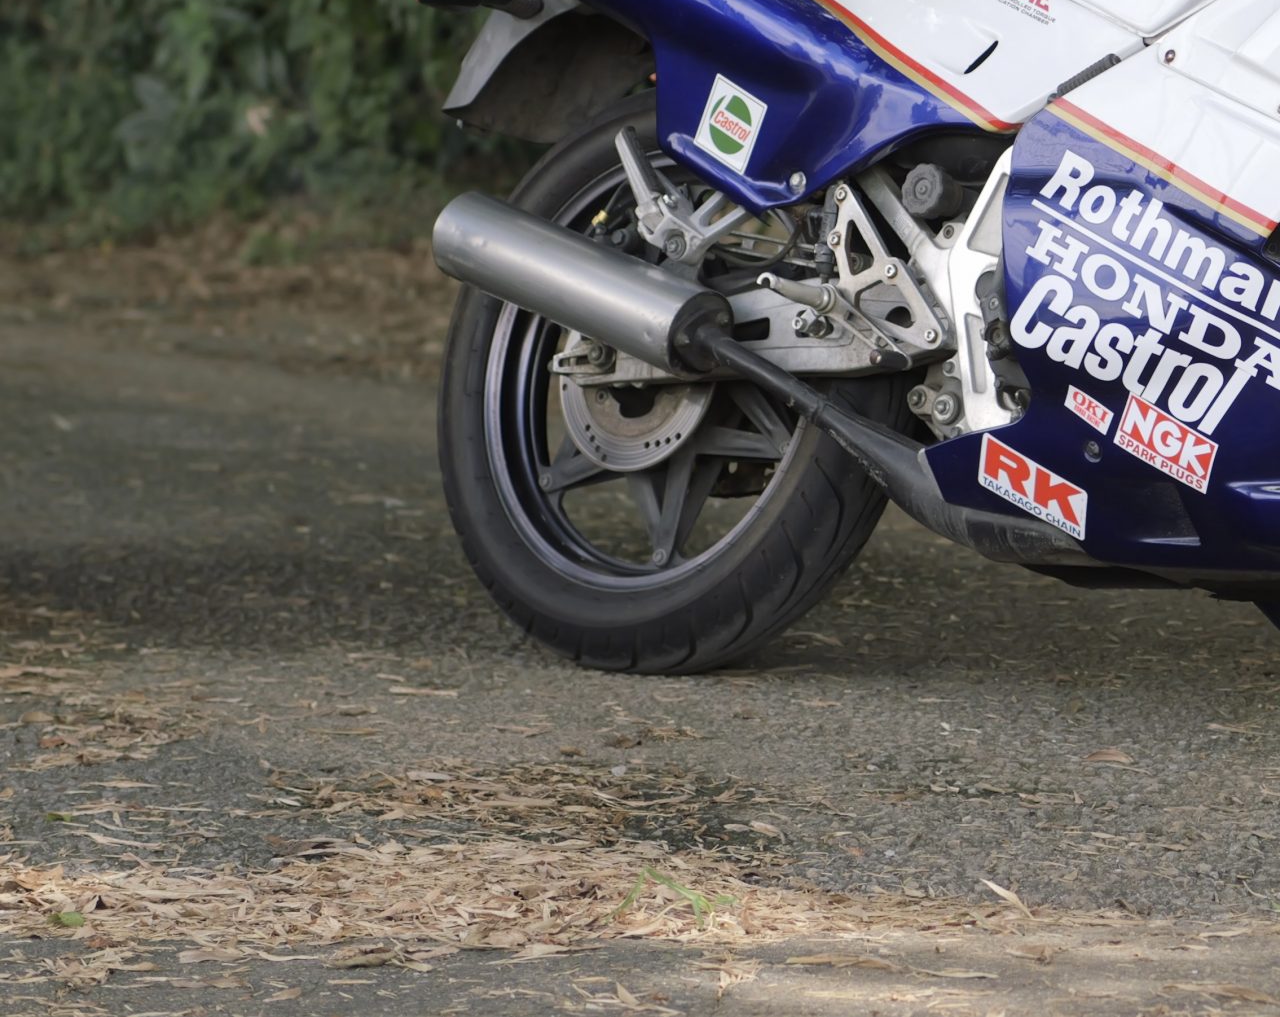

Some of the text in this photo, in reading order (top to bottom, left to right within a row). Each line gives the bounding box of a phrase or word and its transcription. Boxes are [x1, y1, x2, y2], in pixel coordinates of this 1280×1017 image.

[1021, 9, 1049, 25] CHAMBER
[713, 111, 752, 142] Castrol
[1010, 275, 1256, 435] Castrol
[1073, 391, 1109, 424] OKI
[1118, 435, 1204, 490] SPARK PLUGS
[1122, 398, 1212, 477] NGK
[983, 476, 1081, 538] TAKASAGO CHAIN
[984, 437, 1082, 528] RK
